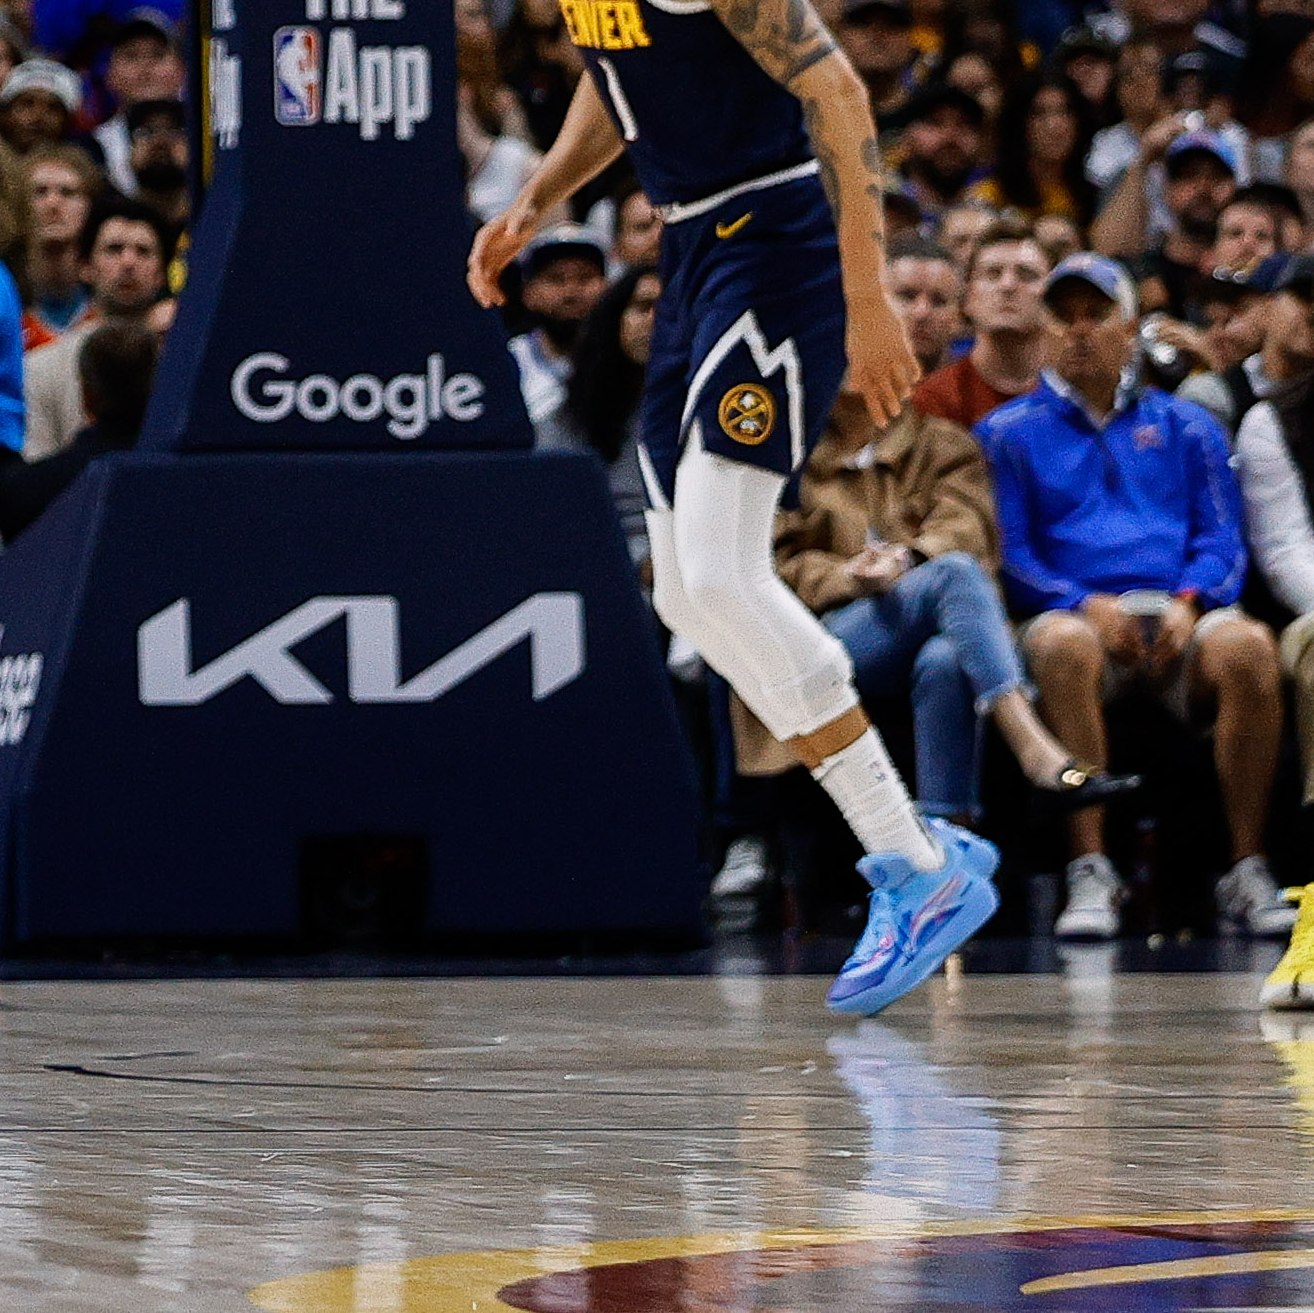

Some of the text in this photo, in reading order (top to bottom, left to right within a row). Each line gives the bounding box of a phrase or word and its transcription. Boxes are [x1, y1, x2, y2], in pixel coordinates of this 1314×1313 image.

[322, 25, 433, 142] App
[230, 350, 487, 442] Google
[136, 590, 587, 706] KIA
